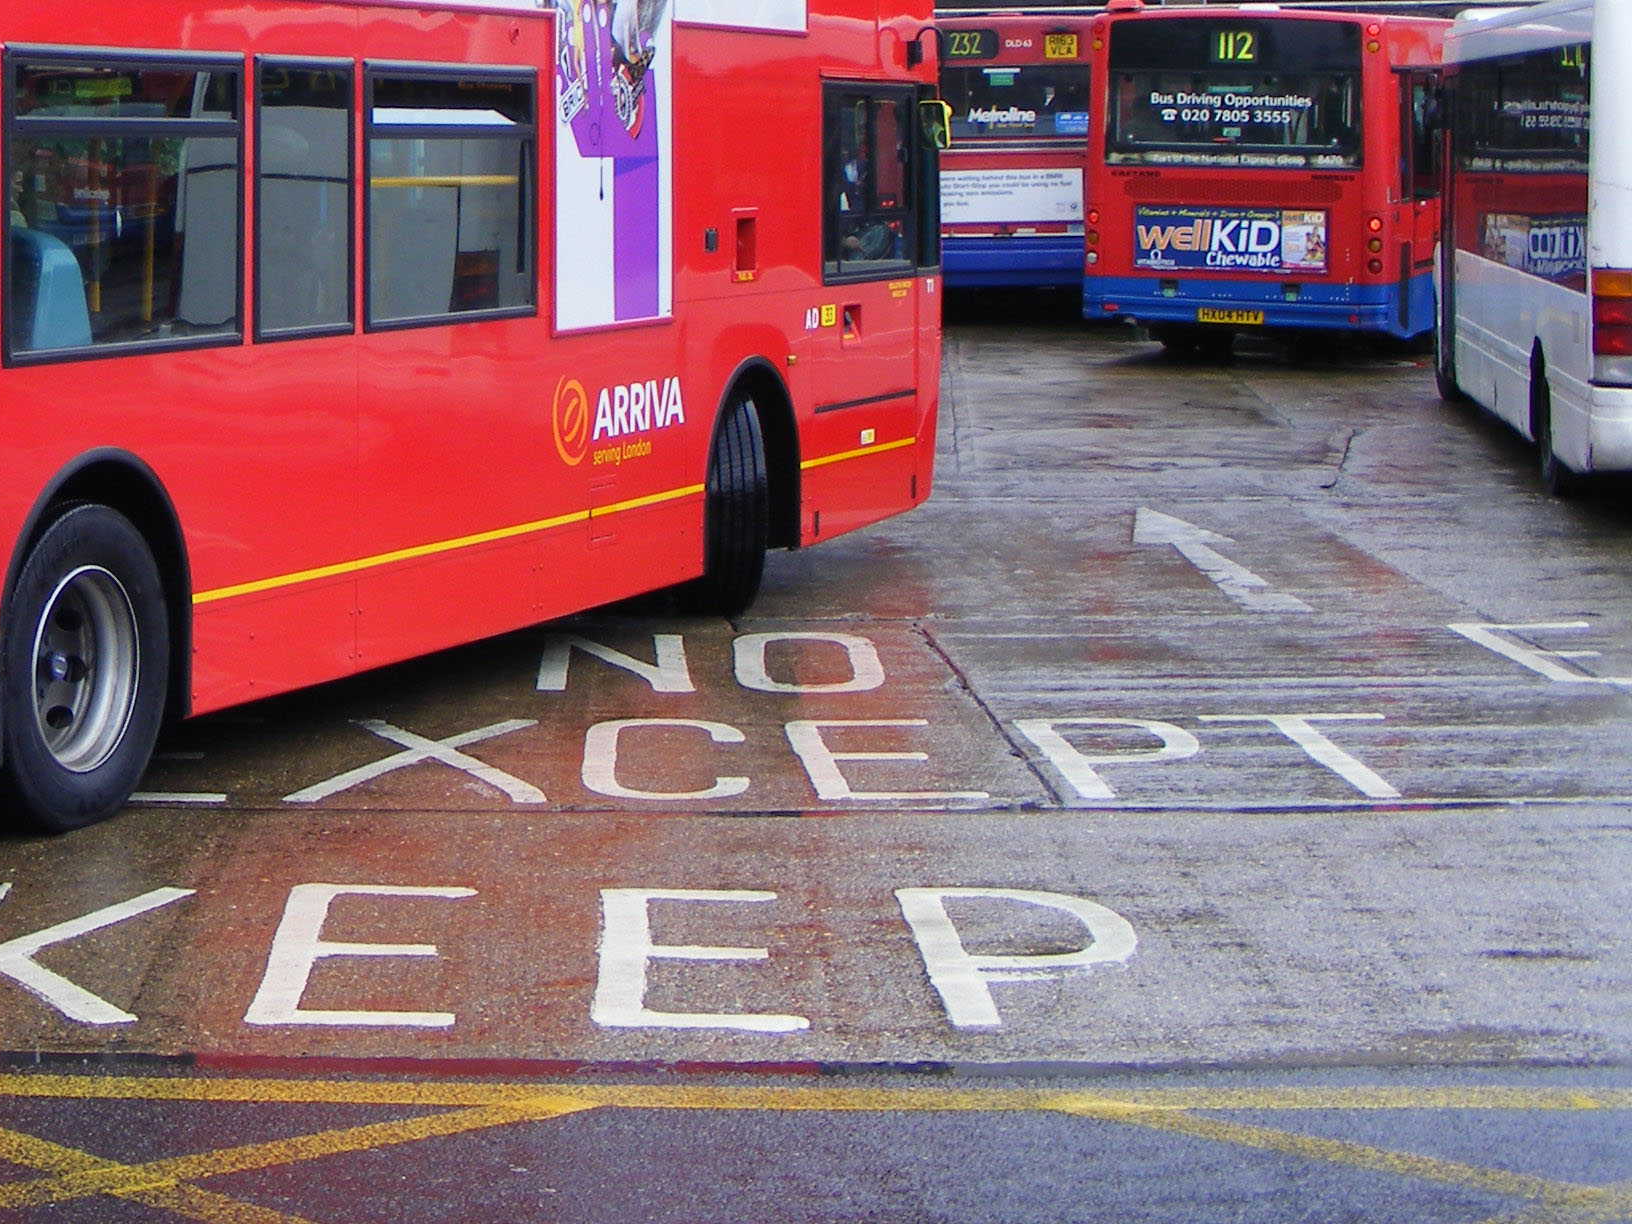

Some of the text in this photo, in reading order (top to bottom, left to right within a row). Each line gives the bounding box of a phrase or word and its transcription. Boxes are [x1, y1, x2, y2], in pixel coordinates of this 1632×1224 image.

[950, 32, 982, 55] 232
[1050, 46, 1073, 56] VLA
[1218, 31, 1254, 60] 112
[1151, 92, 1312, 109] Bus Driving Opportunities
[968, 104, 1036, 126] Metroline
[1181, 109, 1291, 124] 020 7805 3555
[1206, 251, 1281, 267] Chewable
[1236, 311, 1261, 322] HTV
[593, 376, 685, 440] ARRIVA
[593, 437, 652, 466] serving London
[535, 632, 886, 693] NO
[128, 713, 1402, 804] XCEPT
